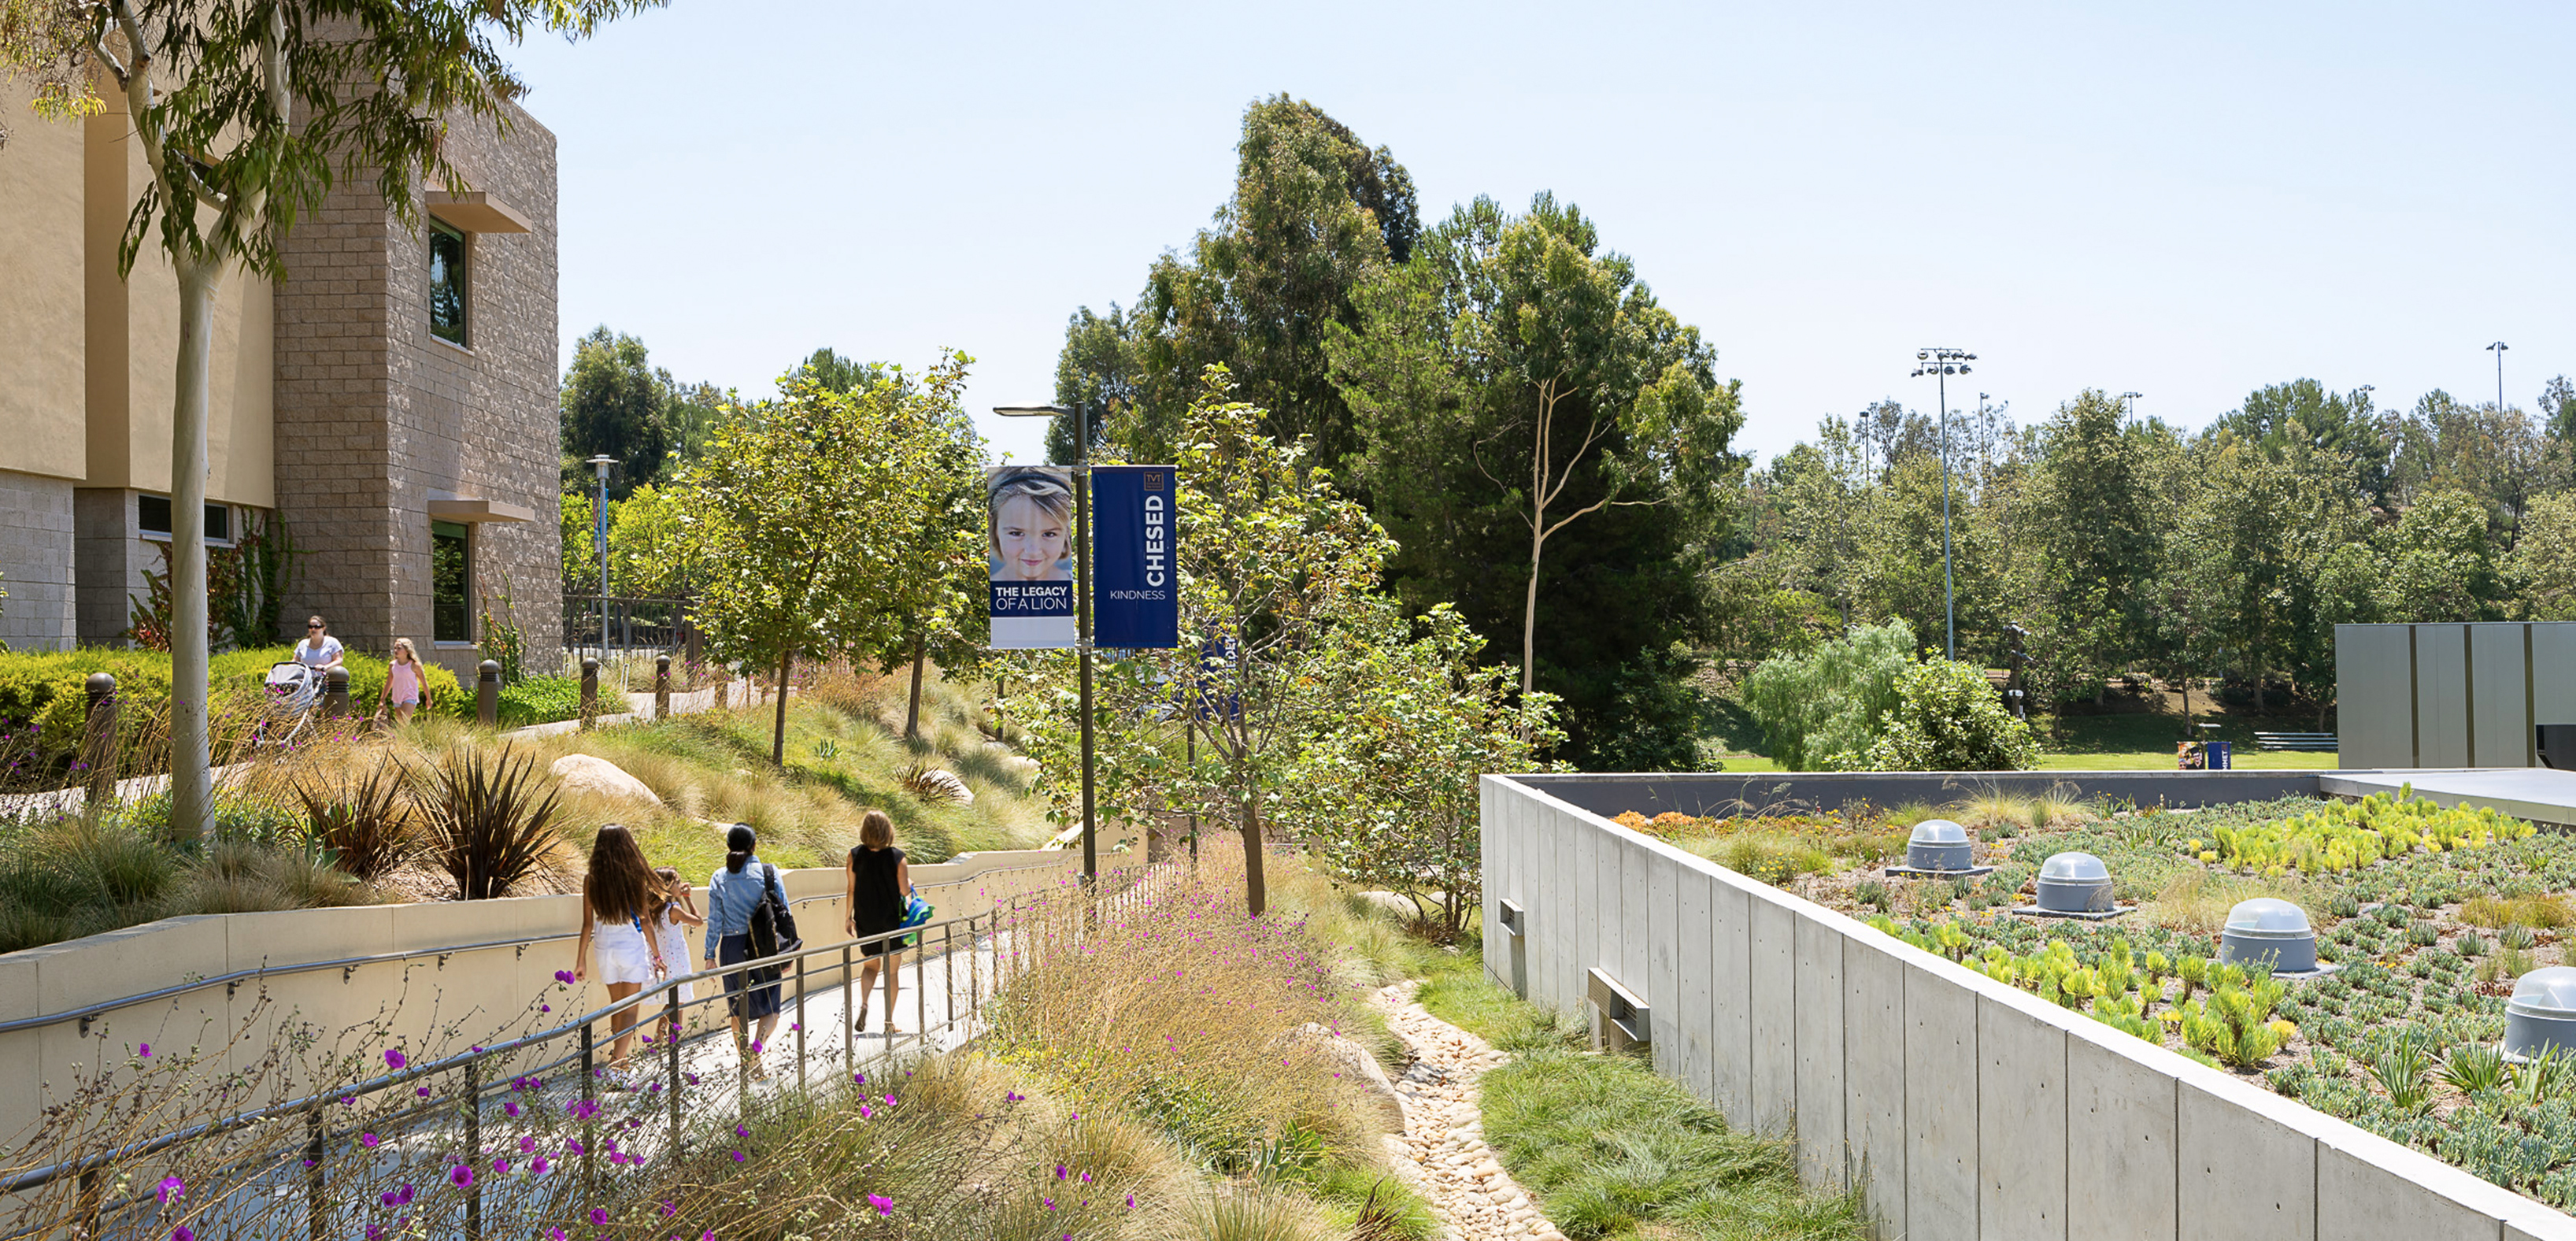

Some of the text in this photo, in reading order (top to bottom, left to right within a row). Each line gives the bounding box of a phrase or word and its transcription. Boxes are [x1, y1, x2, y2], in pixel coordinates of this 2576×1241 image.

[1145, 495, 1165, 587] CHESED
[995, 586, 1068, 597] THE LEGACY
[1110, 590, 1166, 600] KINDNESS
[995, 597, 1067, 610] OF A LION
